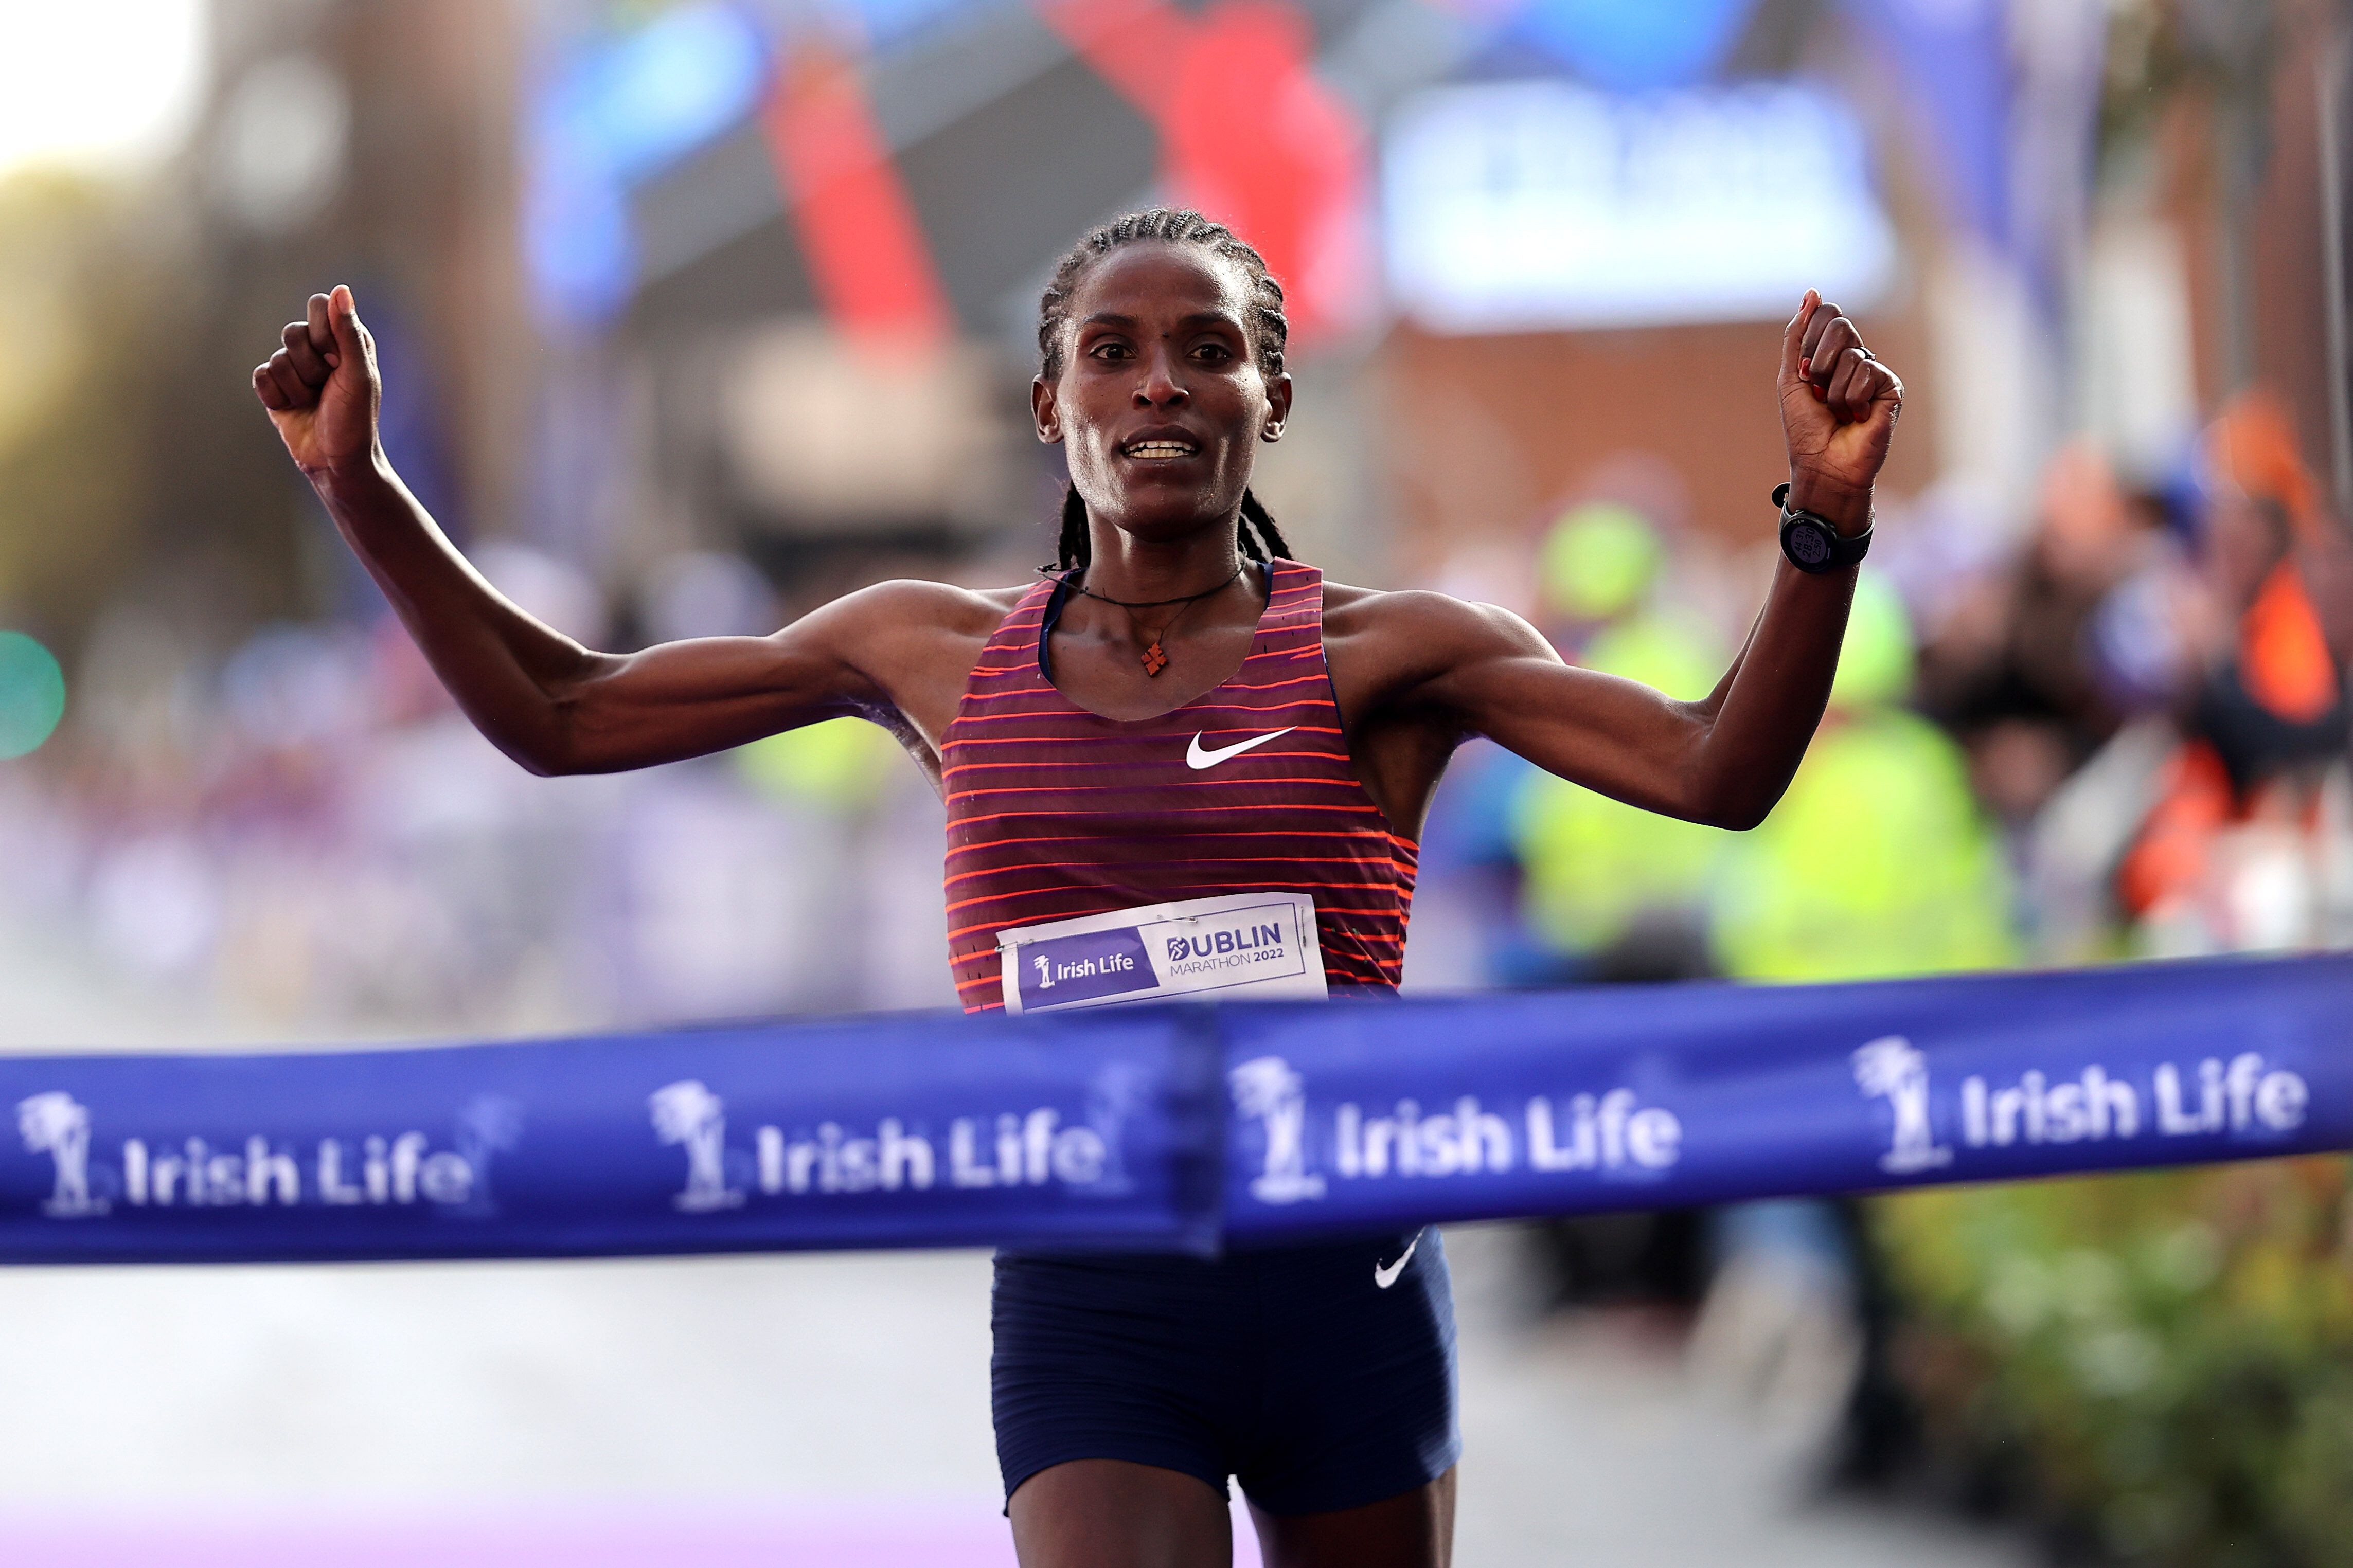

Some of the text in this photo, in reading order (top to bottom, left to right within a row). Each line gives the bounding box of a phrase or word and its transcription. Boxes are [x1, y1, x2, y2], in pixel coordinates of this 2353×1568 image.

[1058, 953, 1134, 980] Irish Life
[1167, 923, 1281, 961] DUBLIN
[1170, 948, 1284, 977] MARATHON 2022
[1340, 1087, 1682, 1179] Irish Life
[1962, 1051, 2309, 1148] Irish Life
[123, 1130, 474, 1207] Irish Life
[756, 1106, 1106, 1195] Irish Life
